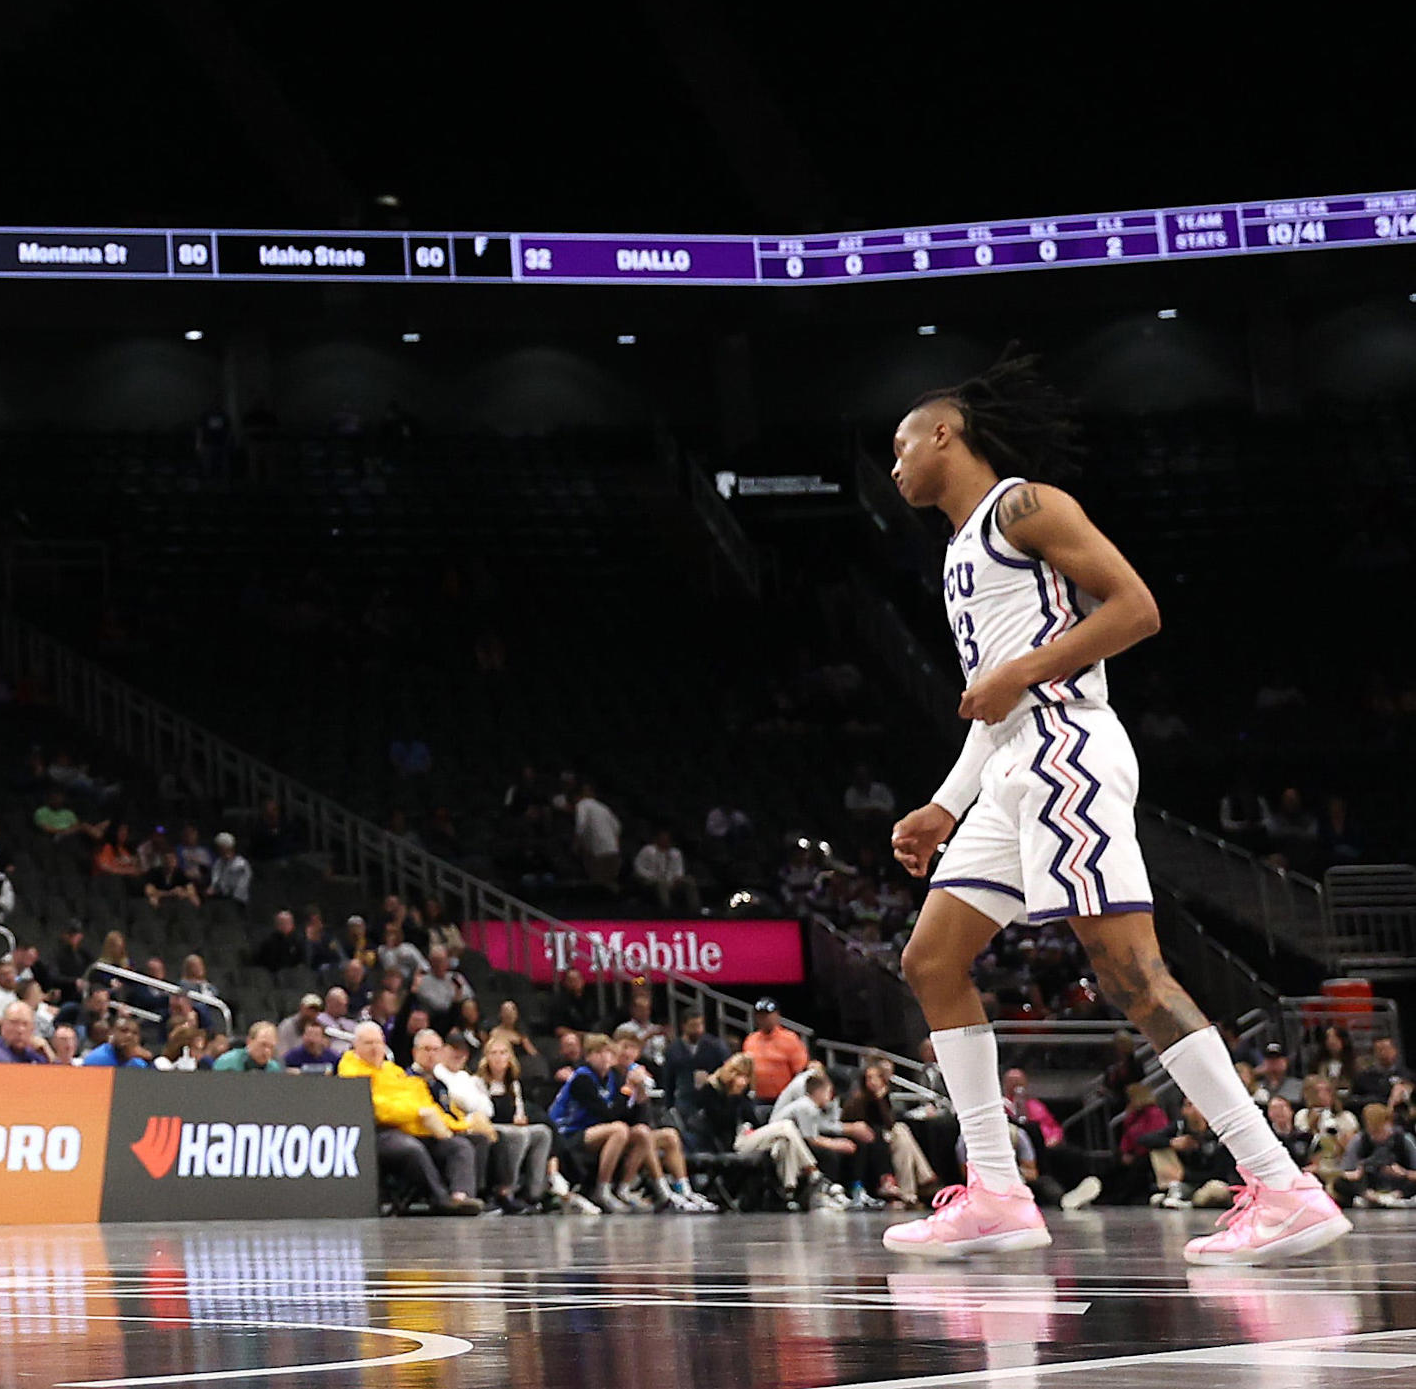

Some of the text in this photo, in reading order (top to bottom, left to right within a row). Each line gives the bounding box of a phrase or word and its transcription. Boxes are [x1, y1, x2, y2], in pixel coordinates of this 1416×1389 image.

[1175, 212, 1224, 231] TEAM
[1267, 220, 1326, 247] 10/41
[1175, 231, 1228, 250] STATS
[18, 242, 102, 264] Montana
[104, 243, 128, 265] St
[259, 244, 312, 267] Idaho
[314, 245, 366, 268] State
[524, 248, 691, 272] 32 DIALLO
[786, 255, 804, 278] 0
[845, 254, 863, 275] 0
[975, 244, 994, 266] 0
[1039, 239, 1058, 262] 0
[943, 562, 975, 602] CU
[953, 611, 979, 671] 3
[589, 930, 724, 973] Mobile
